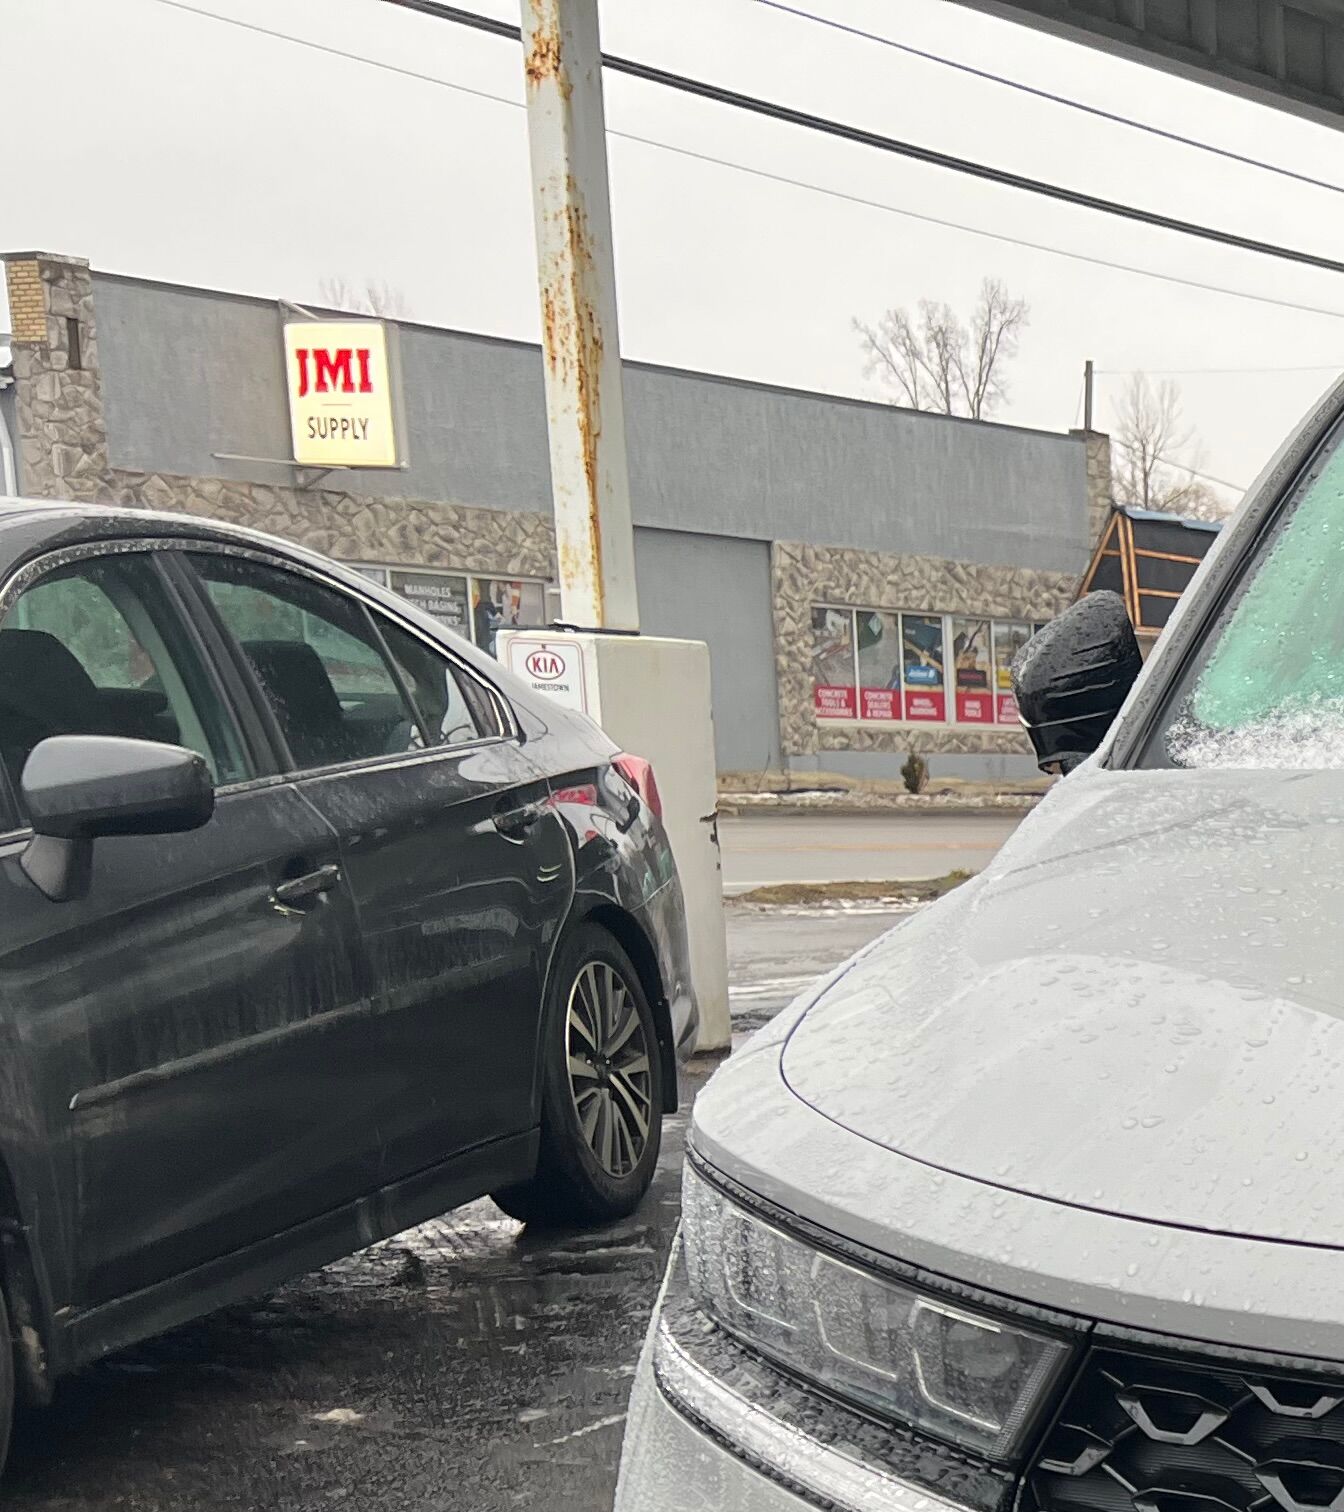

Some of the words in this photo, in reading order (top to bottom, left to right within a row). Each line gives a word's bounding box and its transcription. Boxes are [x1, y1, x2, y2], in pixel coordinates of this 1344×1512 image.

[296, 348, 374, 398] JMI
[307, 416, 369, 440] SUPPLY
[532, 656, 560, 674] KIA
